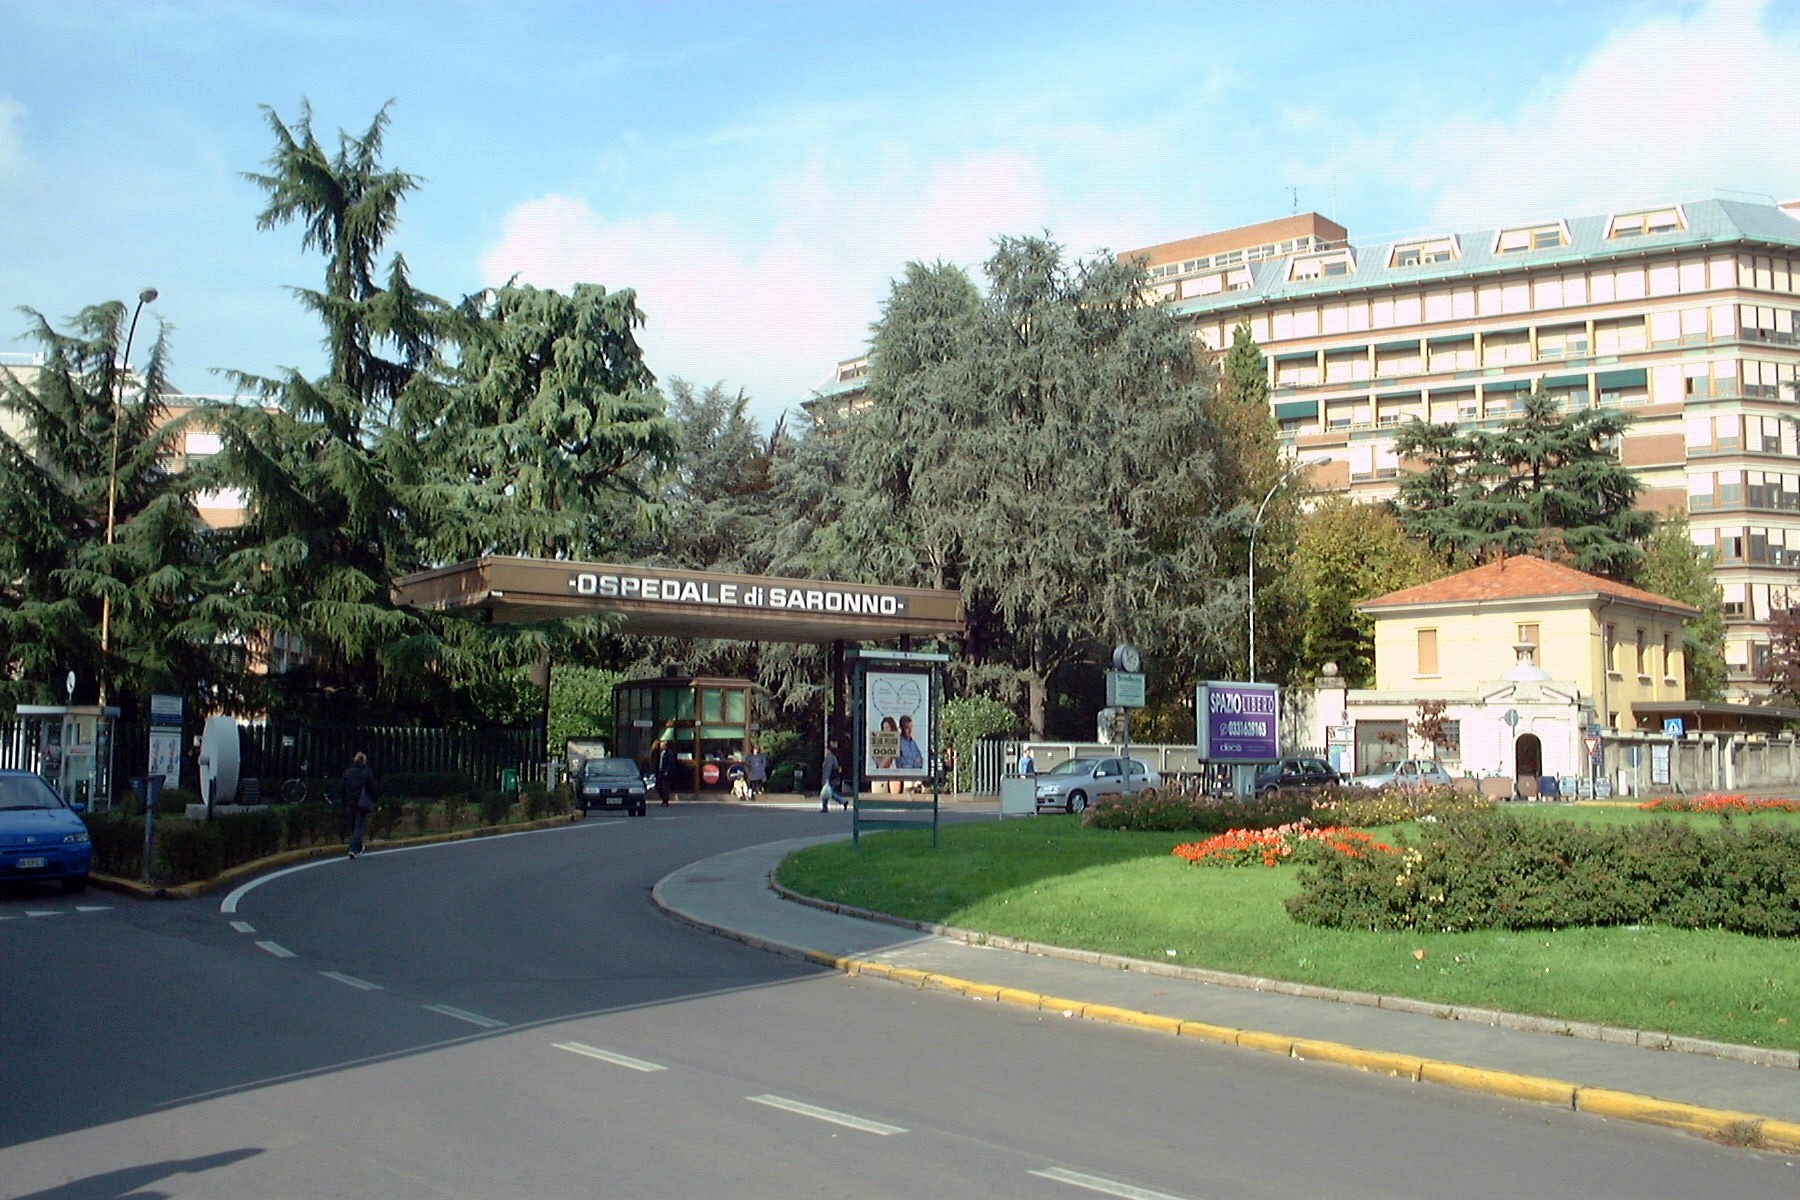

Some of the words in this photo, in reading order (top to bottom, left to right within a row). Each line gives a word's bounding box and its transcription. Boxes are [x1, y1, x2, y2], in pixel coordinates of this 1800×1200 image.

[743, 586, 763, 606] di
[1210, 692, 1241, 713] SPAZIO
[1242, 696, 1274, 713] LIBERO
